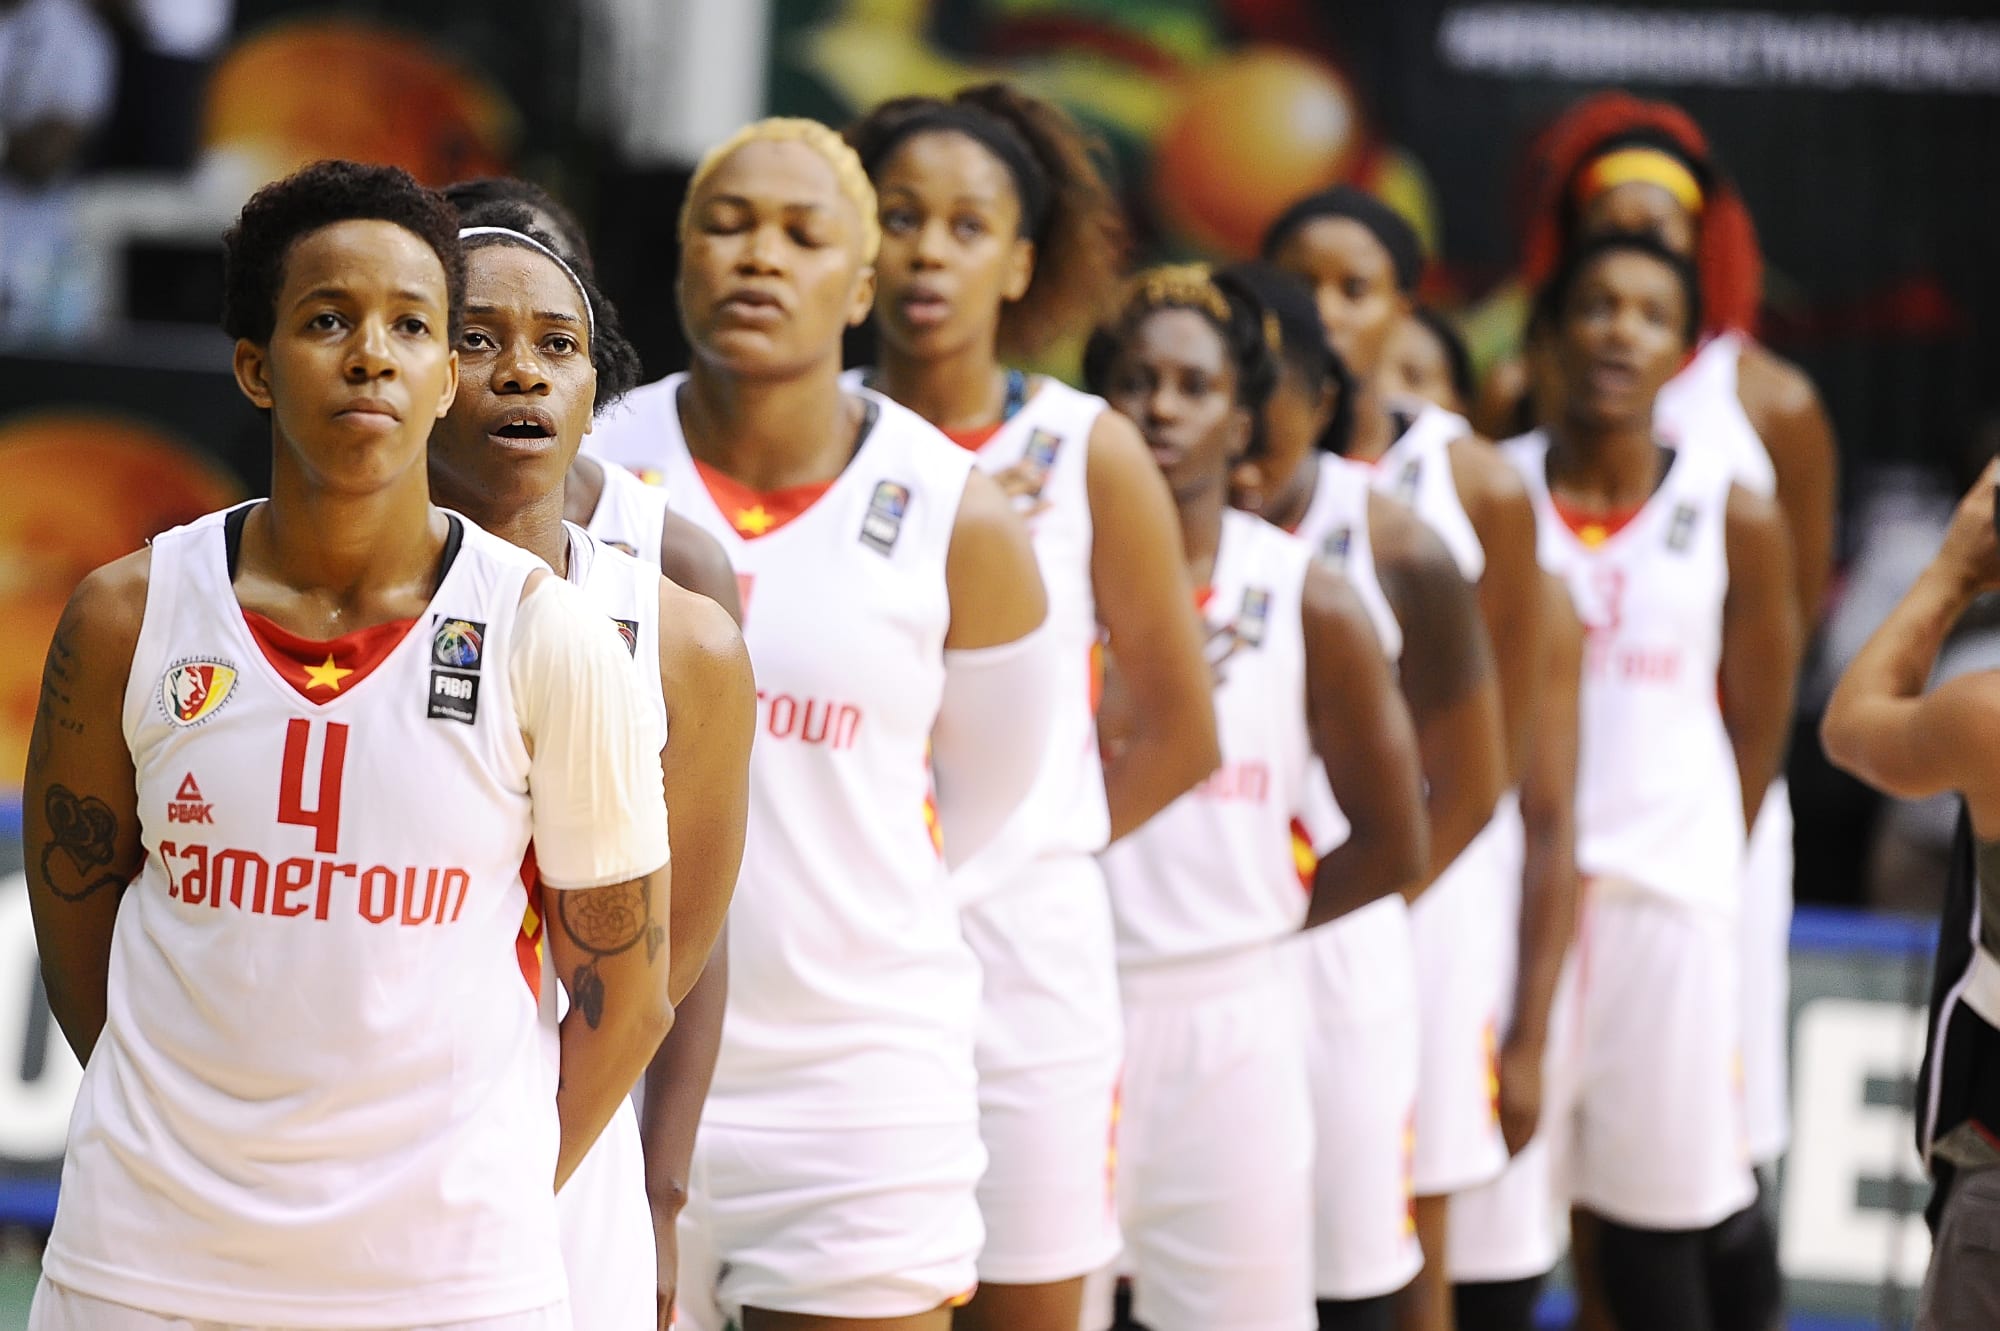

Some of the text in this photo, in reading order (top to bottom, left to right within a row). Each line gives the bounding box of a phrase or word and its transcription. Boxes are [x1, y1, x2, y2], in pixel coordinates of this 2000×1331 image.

[434, 675, 473, 700] FIBA
[277, 718, 349, 854] 4
[167, 802, 215, 824] PEAK
